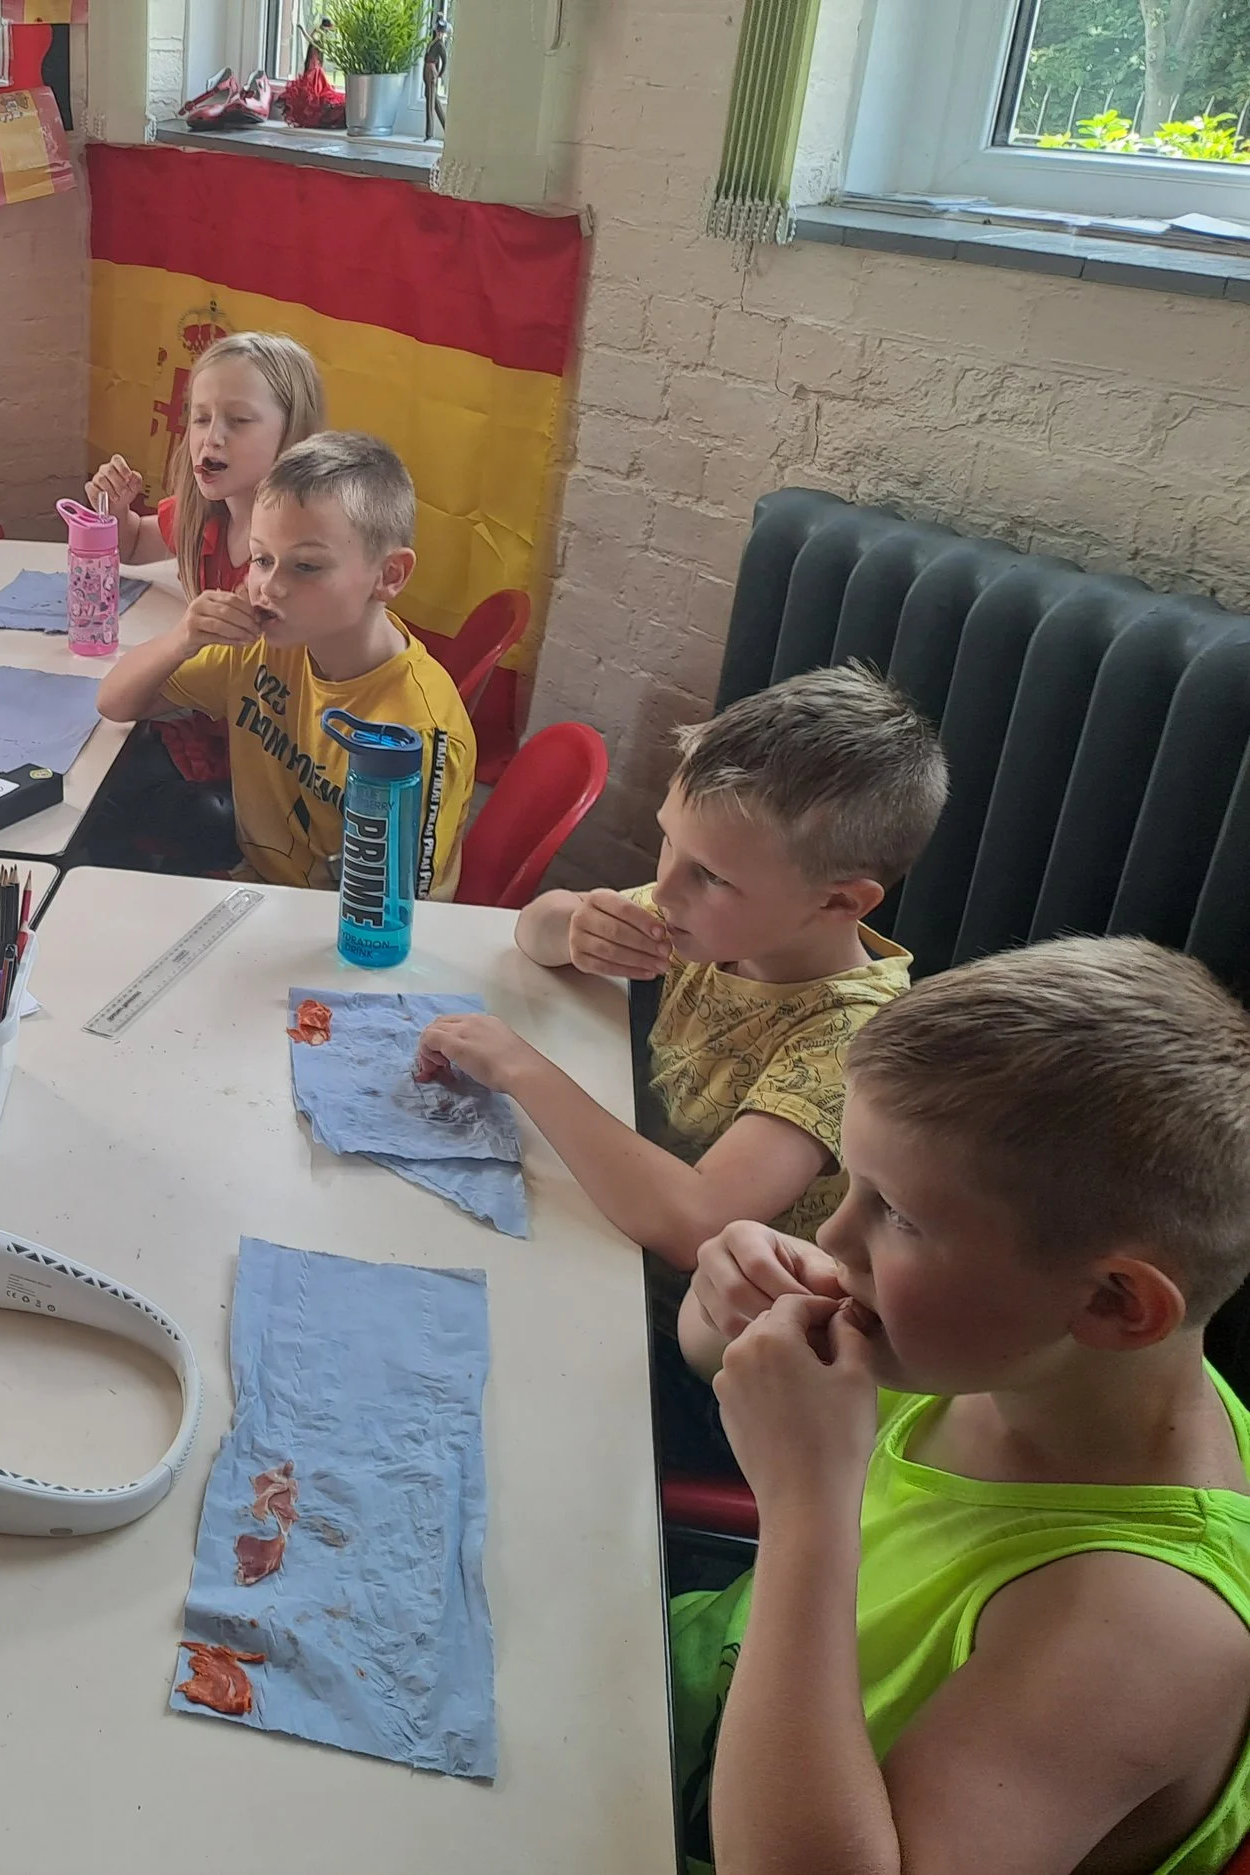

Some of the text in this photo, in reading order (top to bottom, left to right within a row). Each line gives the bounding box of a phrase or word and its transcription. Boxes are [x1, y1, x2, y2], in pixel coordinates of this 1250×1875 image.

[341, 807, 389, 929] PRIME
[341, 931, 390, 949] YDRATION
[345, 943, 374, 959] DRINK
